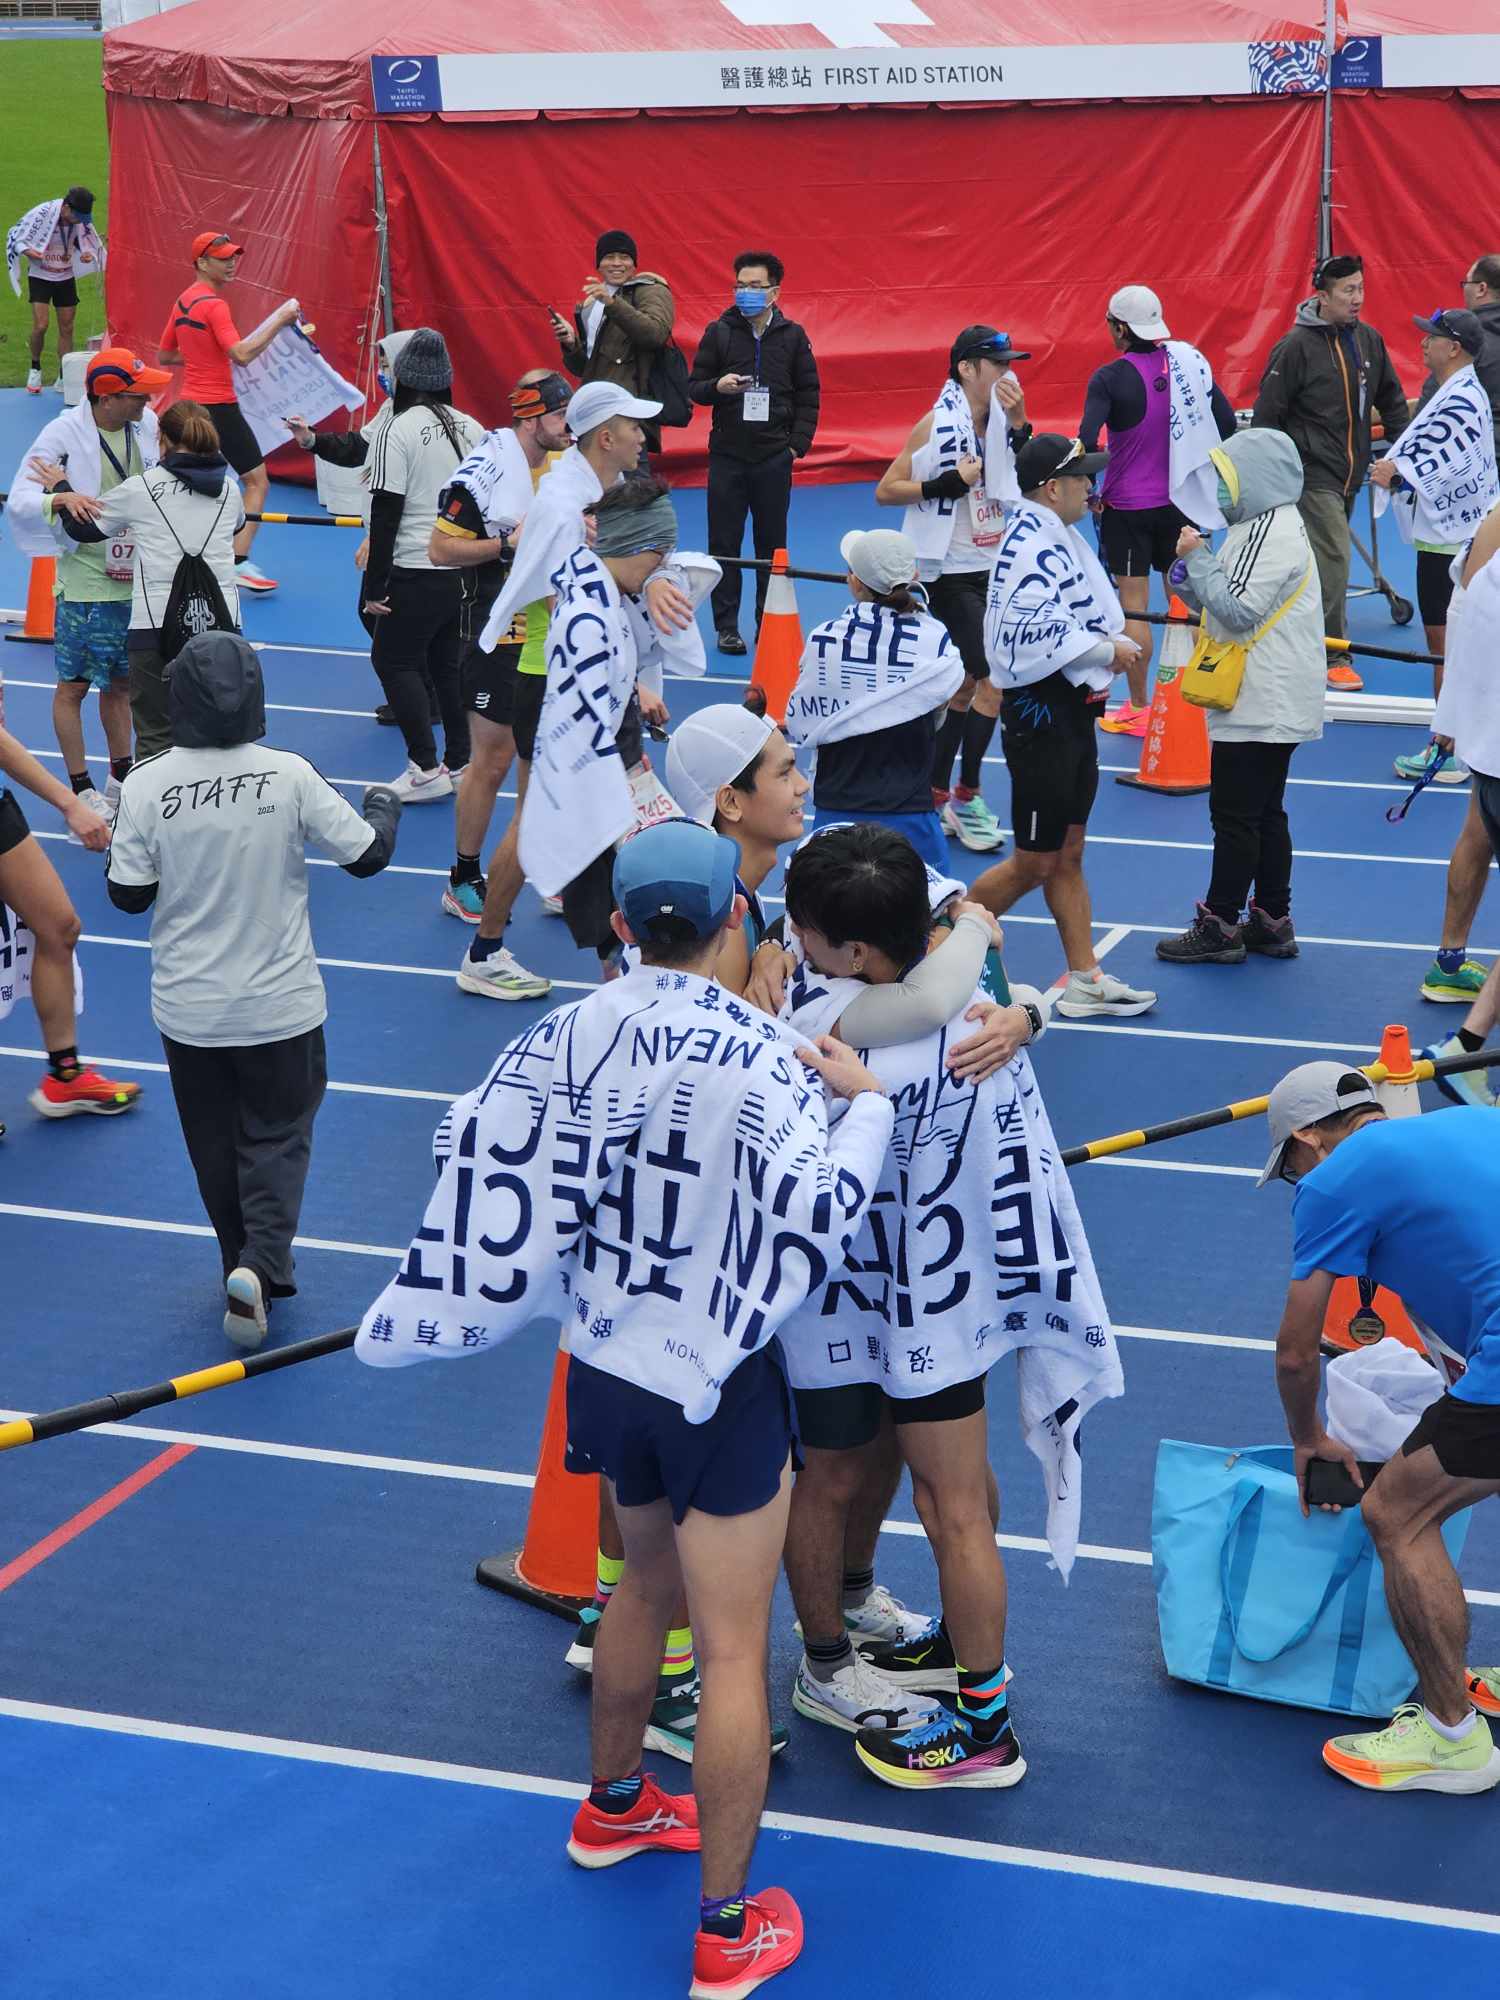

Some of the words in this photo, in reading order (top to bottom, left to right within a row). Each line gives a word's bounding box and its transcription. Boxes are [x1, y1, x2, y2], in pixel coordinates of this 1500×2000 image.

[720, 65, 812, 89] 醫護總站
[824, 67, 880, 86] FIRST
[886, 67, 917, 84] AID
[923, 65, 1004, 84] STATION
[160, 770, 278, 820] STAFF
[257, 804, 275, 816] 2023
[631, 1024, 764, 1070] MEAN
[906, 1743, 967, 1769] HOKA
